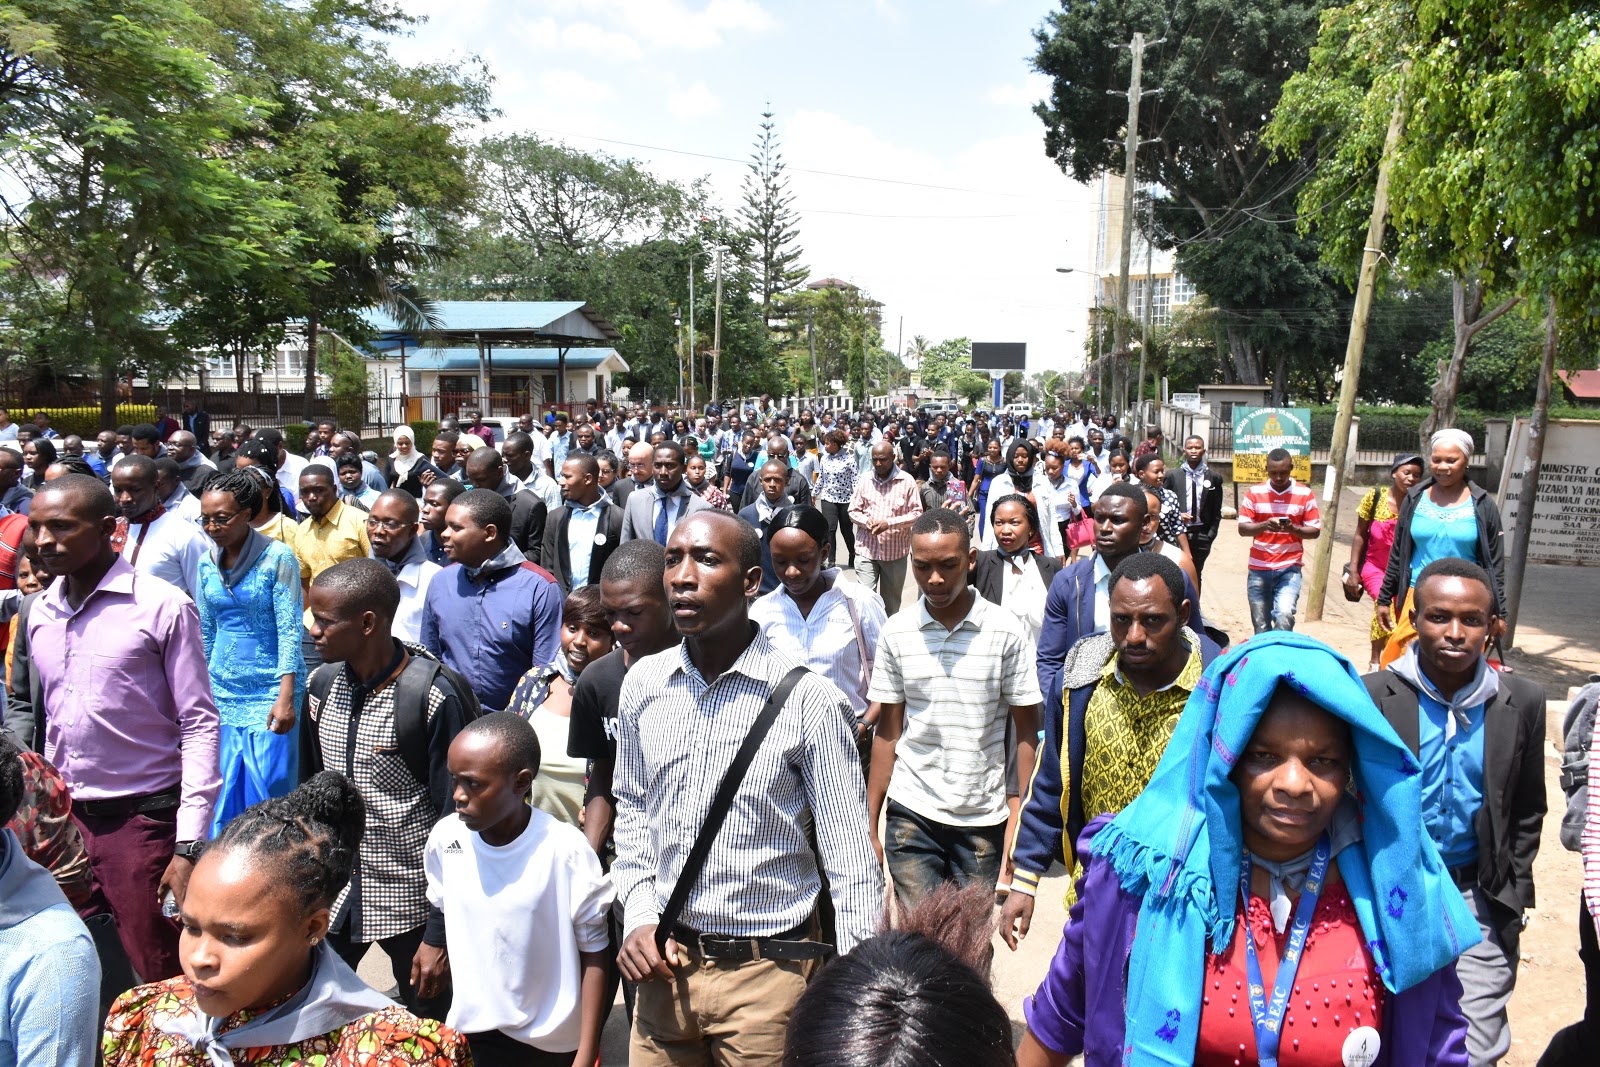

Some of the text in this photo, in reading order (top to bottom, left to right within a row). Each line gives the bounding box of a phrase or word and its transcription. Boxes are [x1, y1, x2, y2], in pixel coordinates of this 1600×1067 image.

[1540, 464, 1589, 475] MINISTRY
[1571, 485, 1583, 496] YA
[1311, 849, 1327, 880] EAC
[1290, 917, 1307, 948] EAC
[1269, 986, 1287, 1018] EAC
